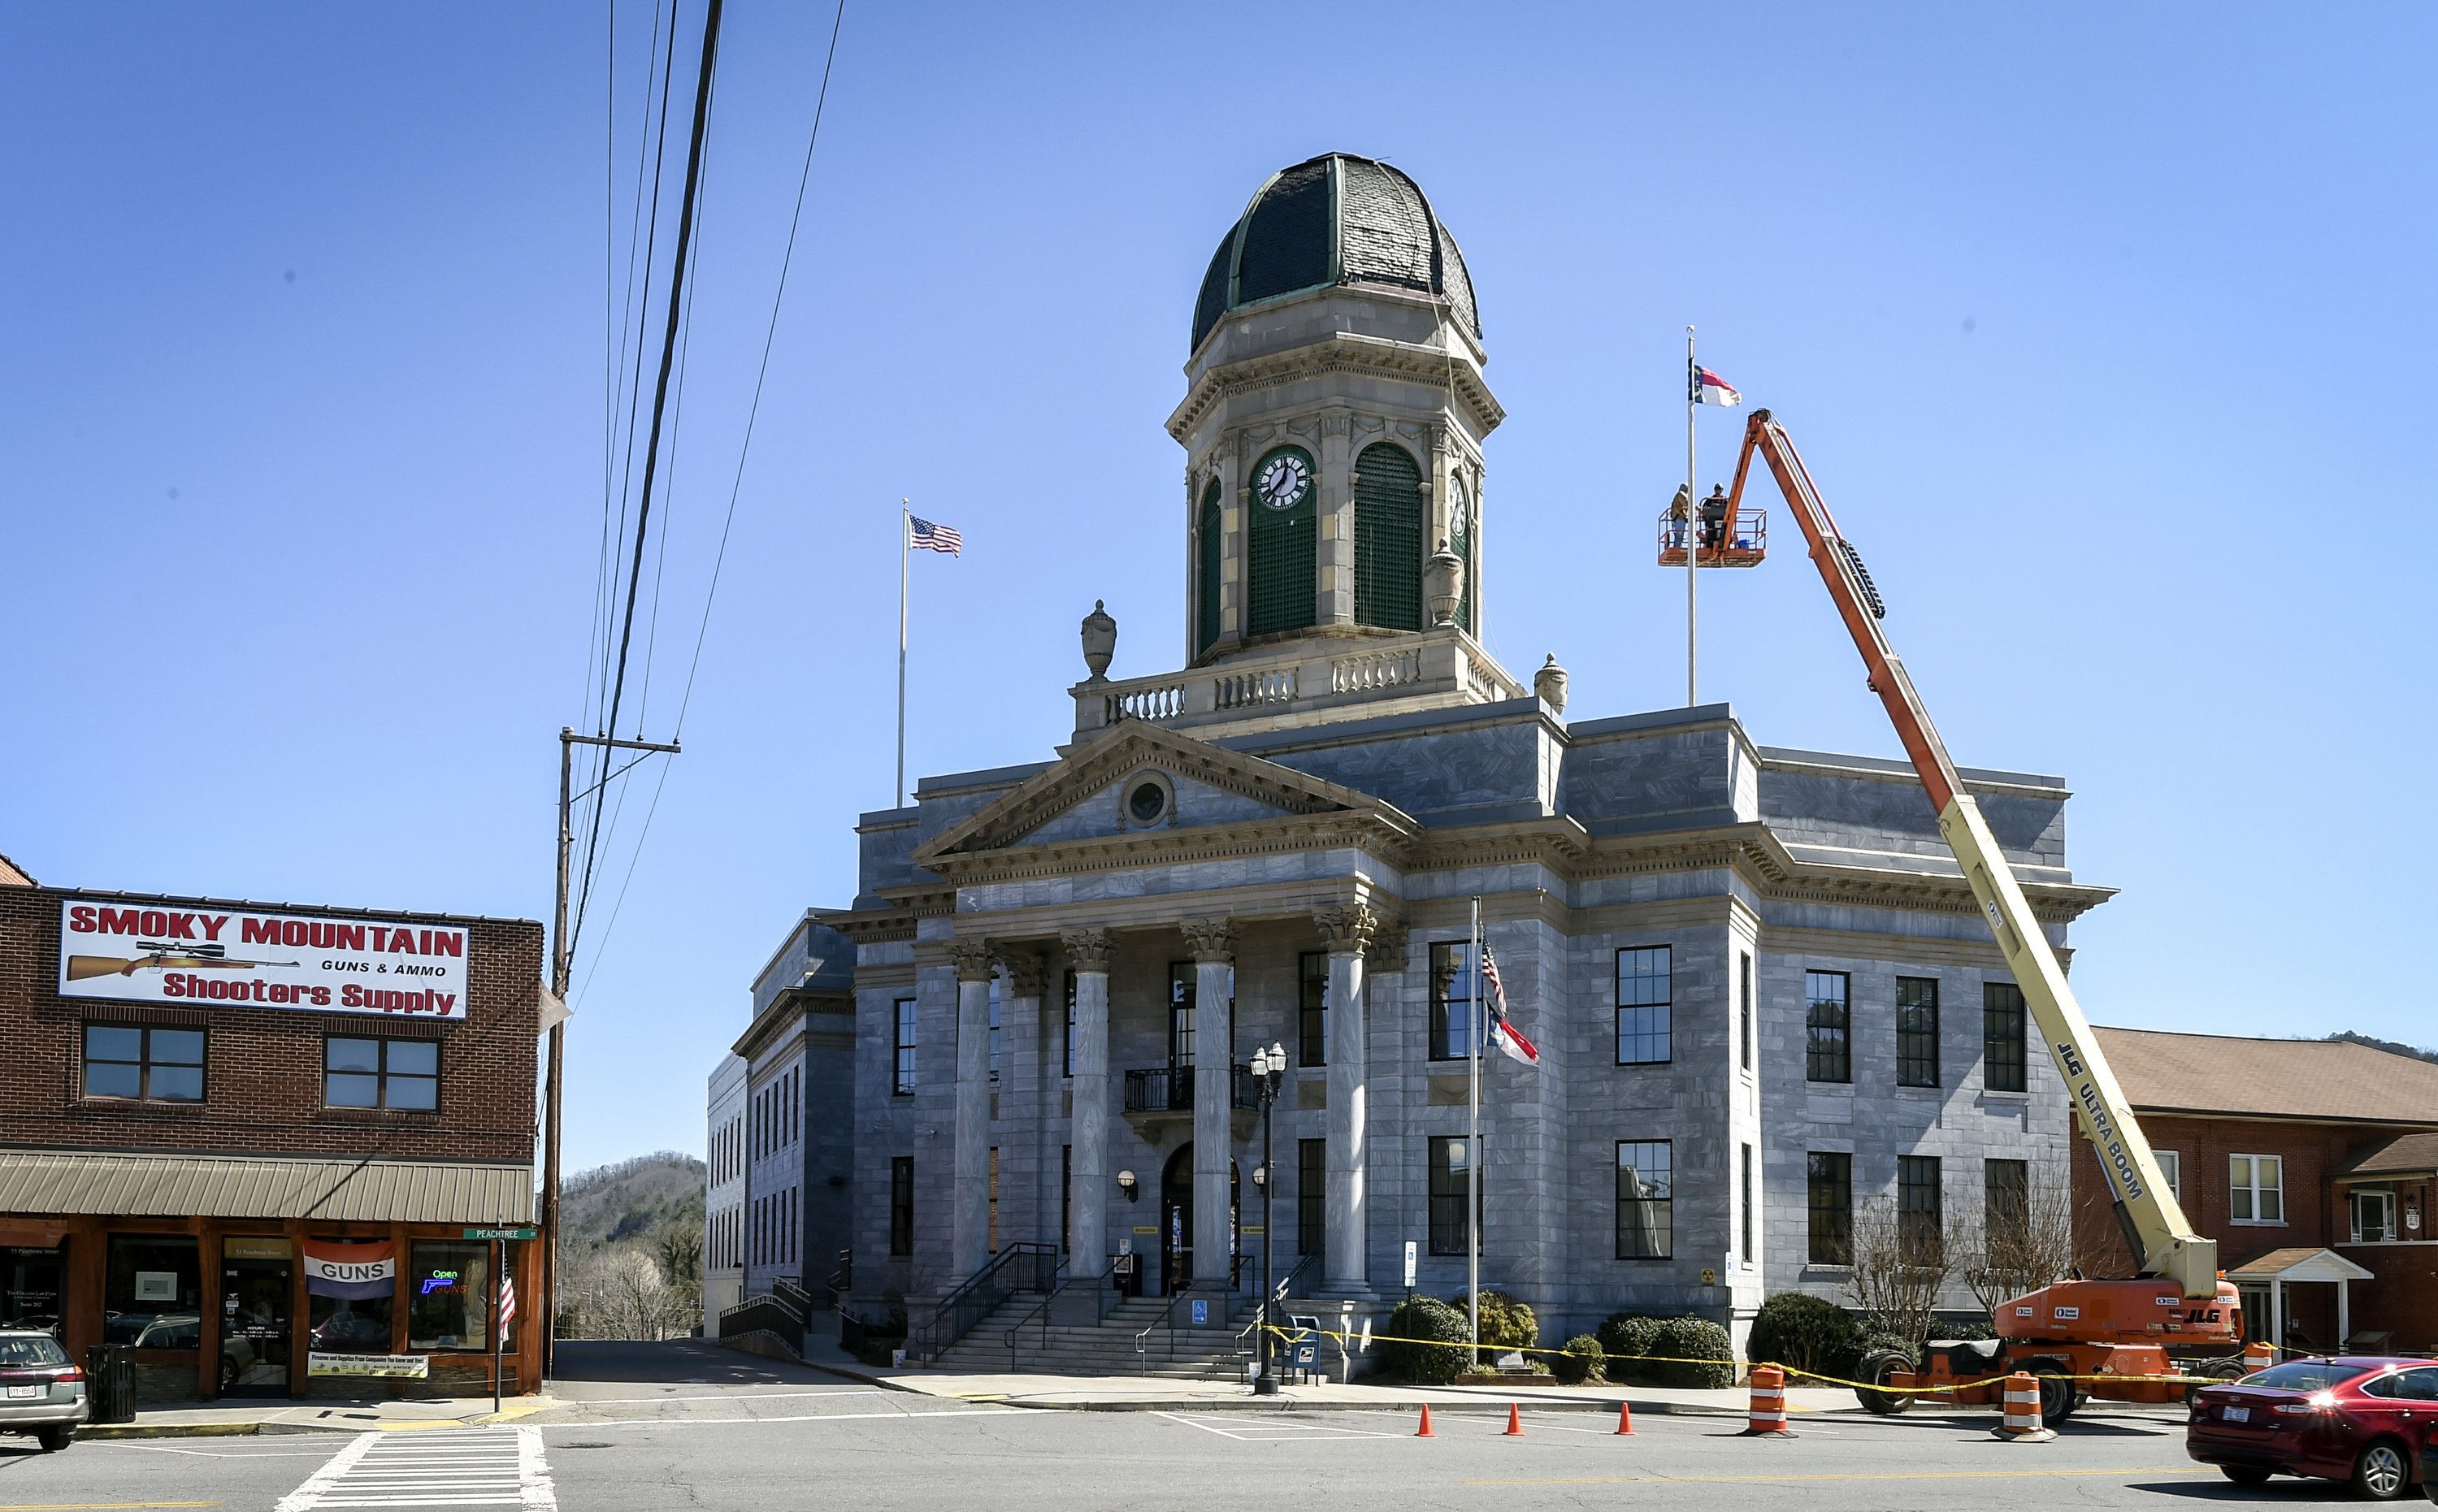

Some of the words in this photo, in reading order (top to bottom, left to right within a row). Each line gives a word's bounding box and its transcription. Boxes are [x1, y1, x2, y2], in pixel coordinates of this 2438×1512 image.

[69, 906, 229, 941] SMOKY
[241, 917, 462, 957] MOUNTAIN
[321, 960, 370, 973] GUNS
[376, 964, 388, 973] &
[394, 964, 446, 977] AMMO
[163, 973, 331, 1006] Shooters
[341, 984, 457, 1016] Supply
[2057, 1042, 2083, 1077] JLG
[2080, 1083, 2113, 1142] ULTRA
[2107, 1141, 2144, 1200] BOOM
[476, 1229, 518, 1239] PEACHTREE
[321, 1263, 384, 1280] GUNS
[432, 1270, 458, 1279] Open
[435, 1285, 469, 1294] GUNS
[2183, 1309, 2220, 1324] JLG
